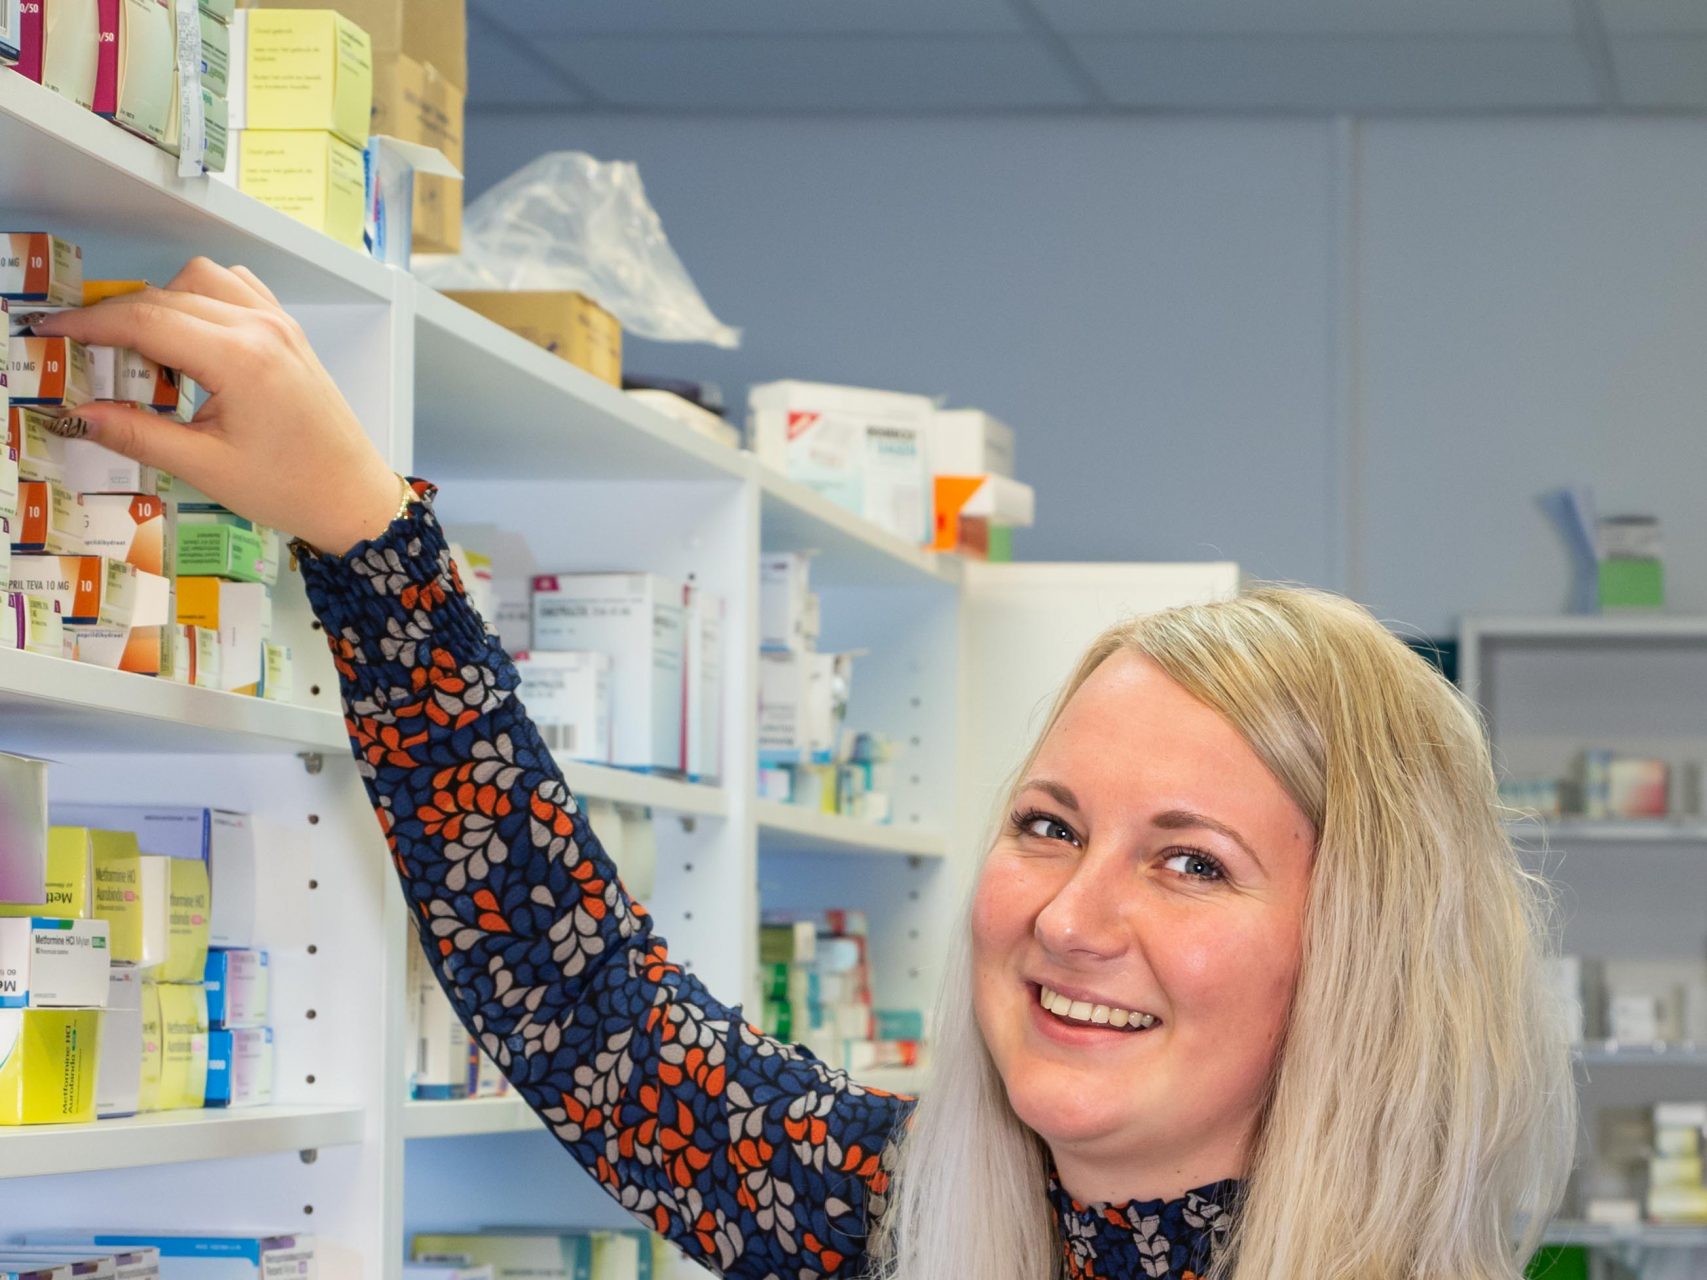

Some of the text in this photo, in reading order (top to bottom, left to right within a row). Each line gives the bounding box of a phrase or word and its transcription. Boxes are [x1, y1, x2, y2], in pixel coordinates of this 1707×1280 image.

[99, 32, 115, 42] /50
[31, 256, 43, 269] 10
[23, 361, 36, 372] MG
[47, 361, 59, 373] 10
[138, 369, 150, 380] MG
[28, 506, 40, 518] 10
[138, 502, 152, 518] 10
[26, 579, 44, 591] TEVA
[46, 579, 56, 591] 10
[57, 580, 70, 592] MG
[80, 579, 93, 592] 10
